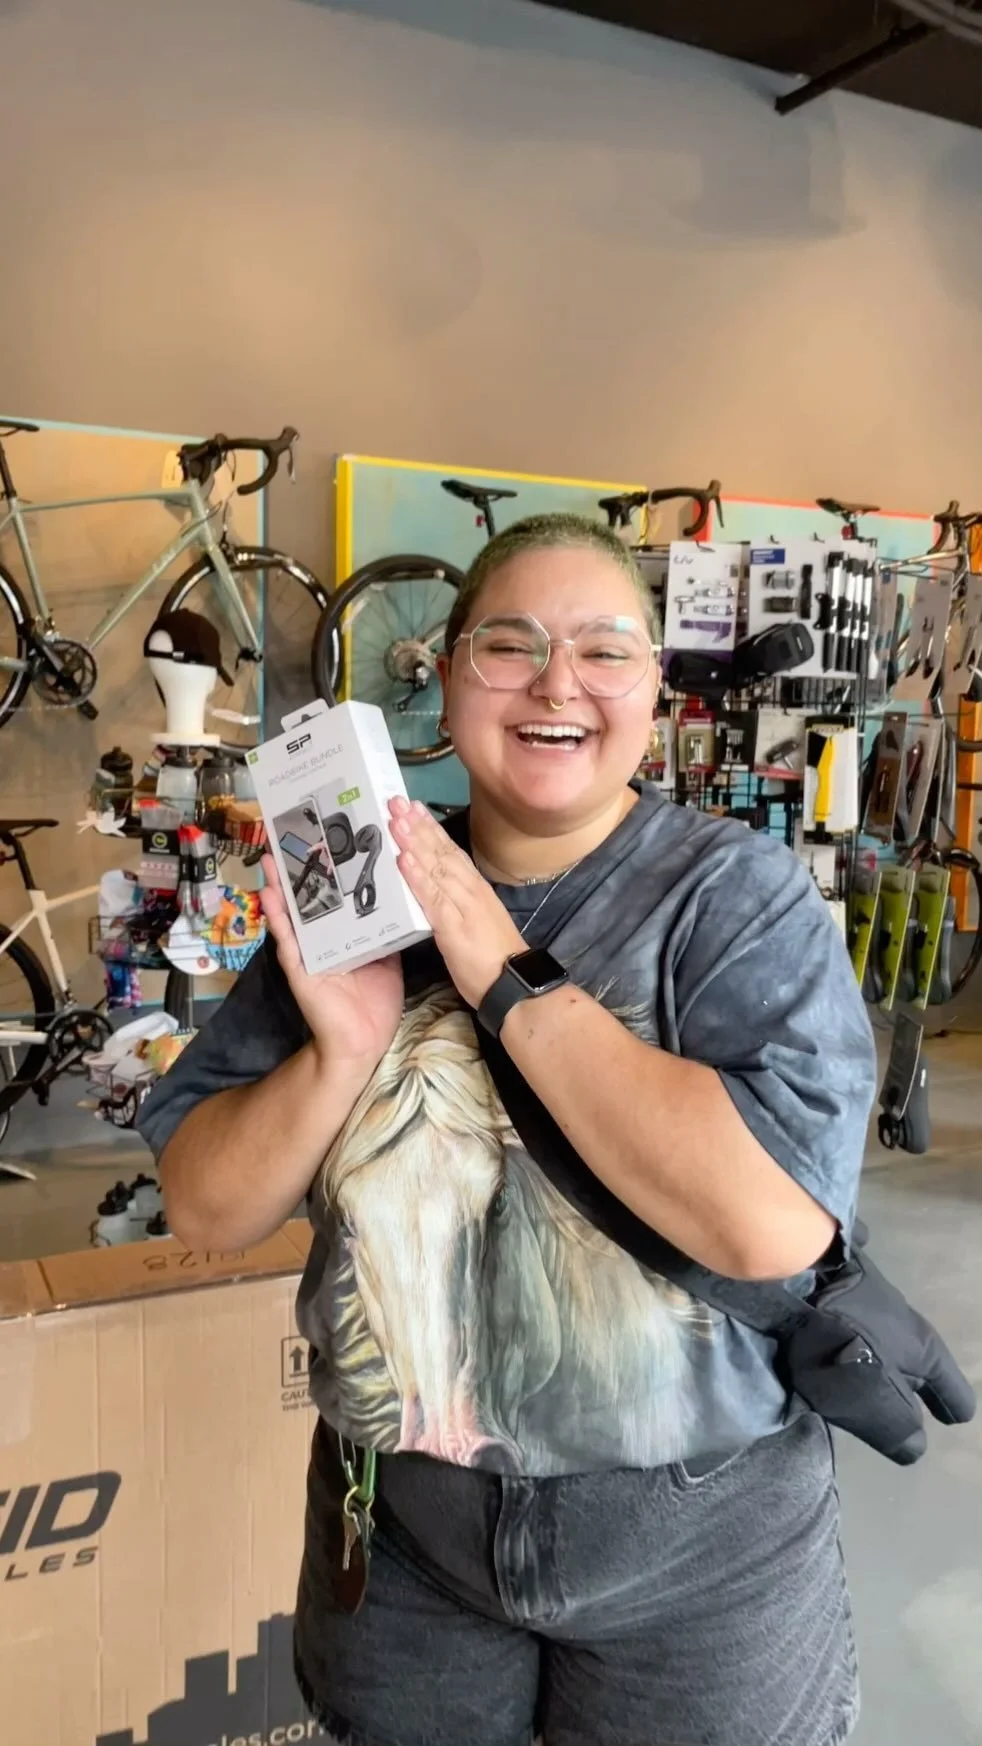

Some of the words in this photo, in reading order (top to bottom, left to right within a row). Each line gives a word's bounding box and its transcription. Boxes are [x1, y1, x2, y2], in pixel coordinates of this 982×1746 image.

[286, 732, 312, 754] SP
[310, 743, 345, 768] BUNDLE
[281, 1389, 308, 1402] CAU
[0, 1470, 122, 1555] ID
